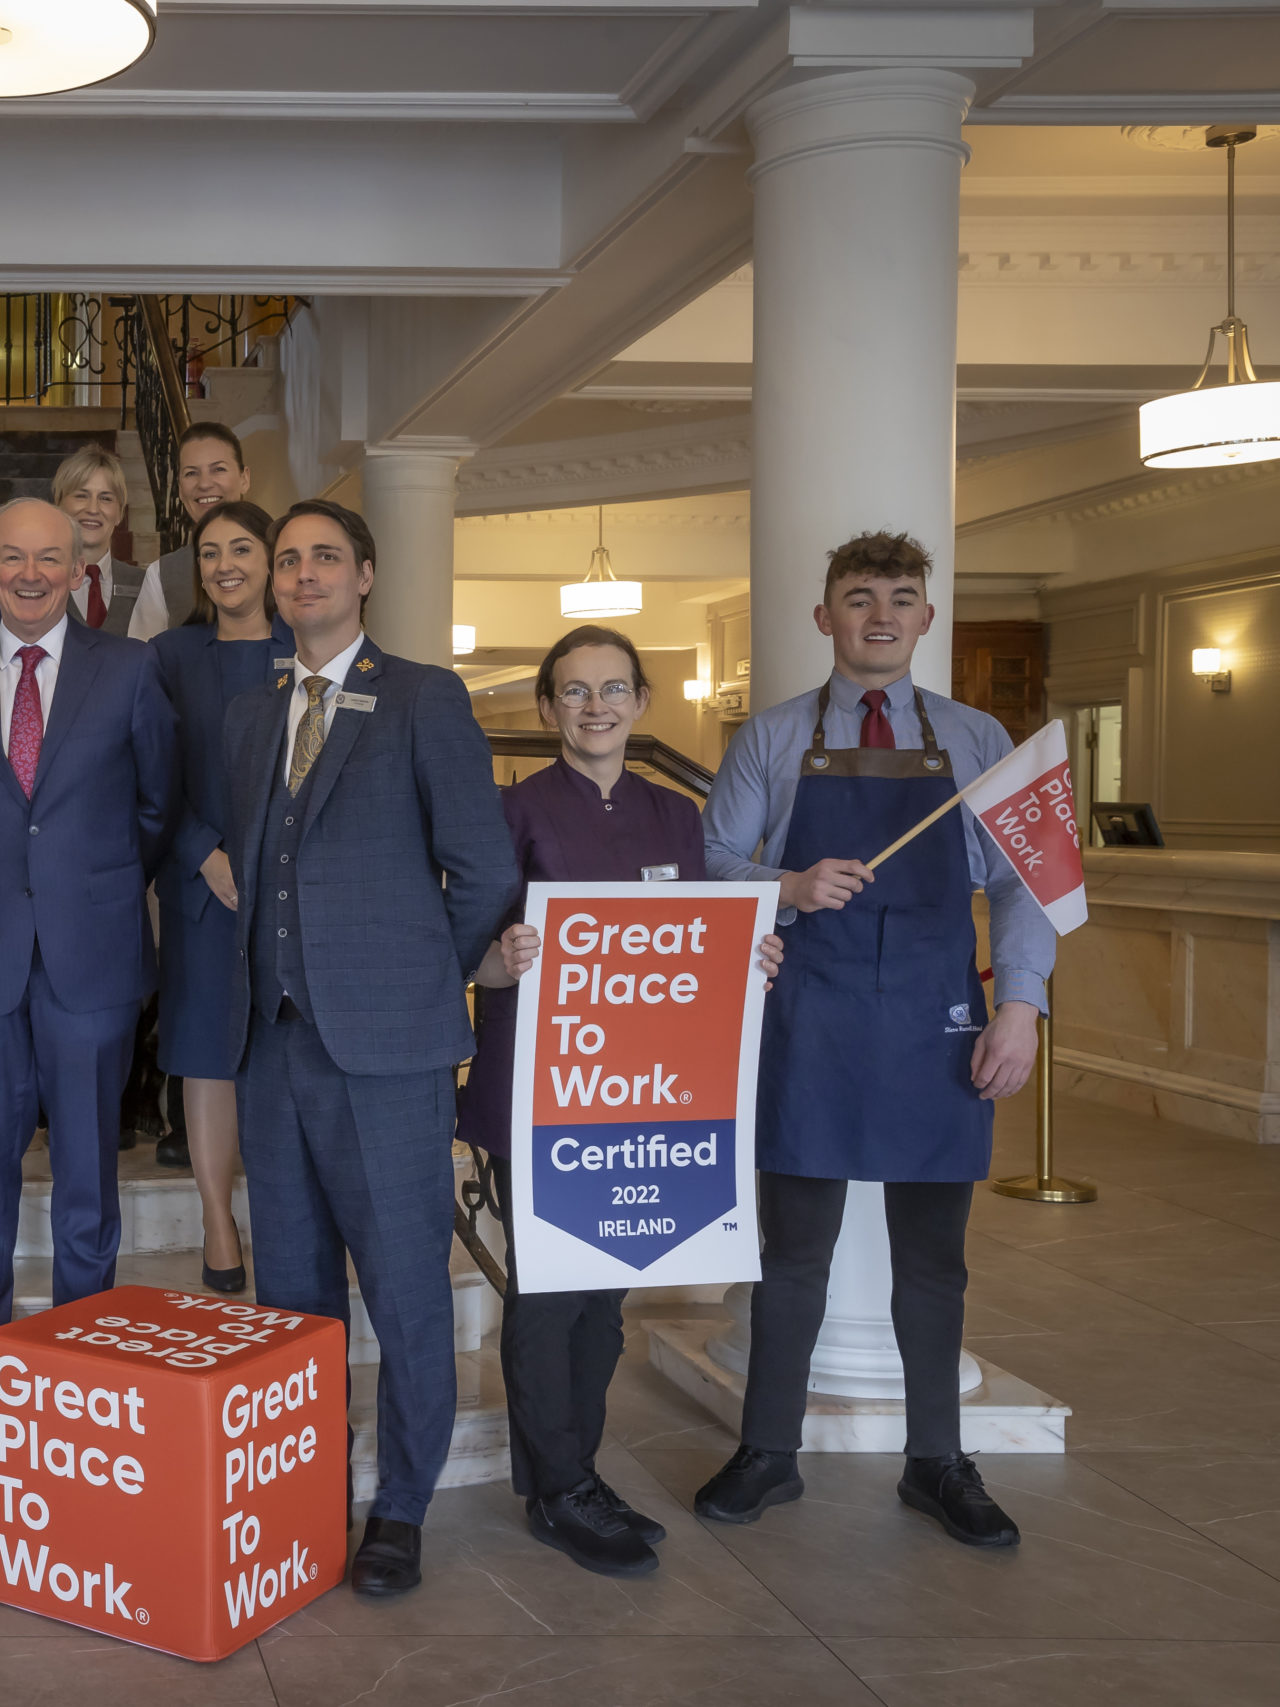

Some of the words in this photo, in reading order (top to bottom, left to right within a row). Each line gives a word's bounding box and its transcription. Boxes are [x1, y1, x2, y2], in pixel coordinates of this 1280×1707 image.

[1019, 792, 1041, 822] To
[558, 912, 708, 956] Great
[557, 963, 699, 1005] Place
[551, 1015, 606, 1055] To
[550, 1132, 717, 1172] Certified
[611, 1184, 660, 1205] 2022
[598, 1217, 676, 1238] IRELAND
[55, 1327, 218, 1368] Great
[94, 1316, 252, 1356] Place
[218, 1322, 275, 1343] To
[222, 1357, 318, 1439] Great
[225, 1425, 317, 1504] Place
[222, 1510, 261, 1565] To
